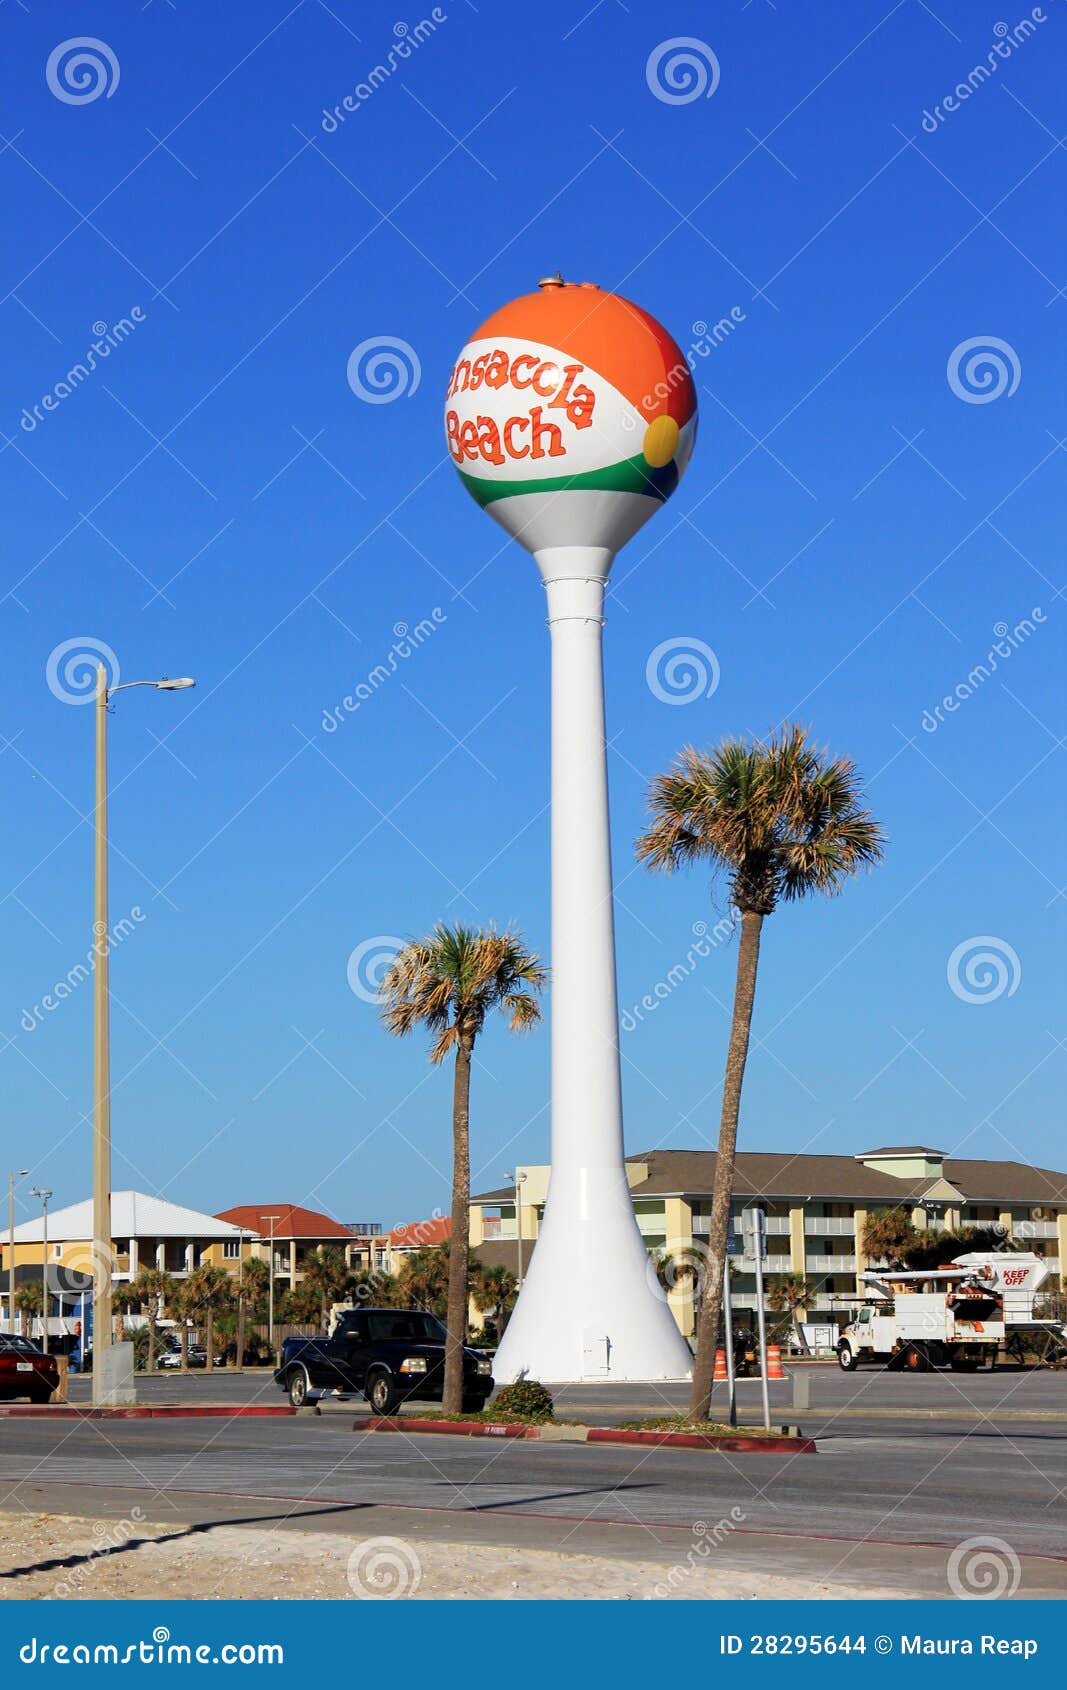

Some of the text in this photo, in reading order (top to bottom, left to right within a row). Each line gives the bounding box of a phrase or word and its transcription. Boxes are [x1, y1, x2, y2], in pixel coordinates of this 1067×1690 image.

[446, 406, 567, 466] Beach
[1003, 1269, 1030, 1278] KEEP
[1005, 1277, 1025, 1285] OFF
